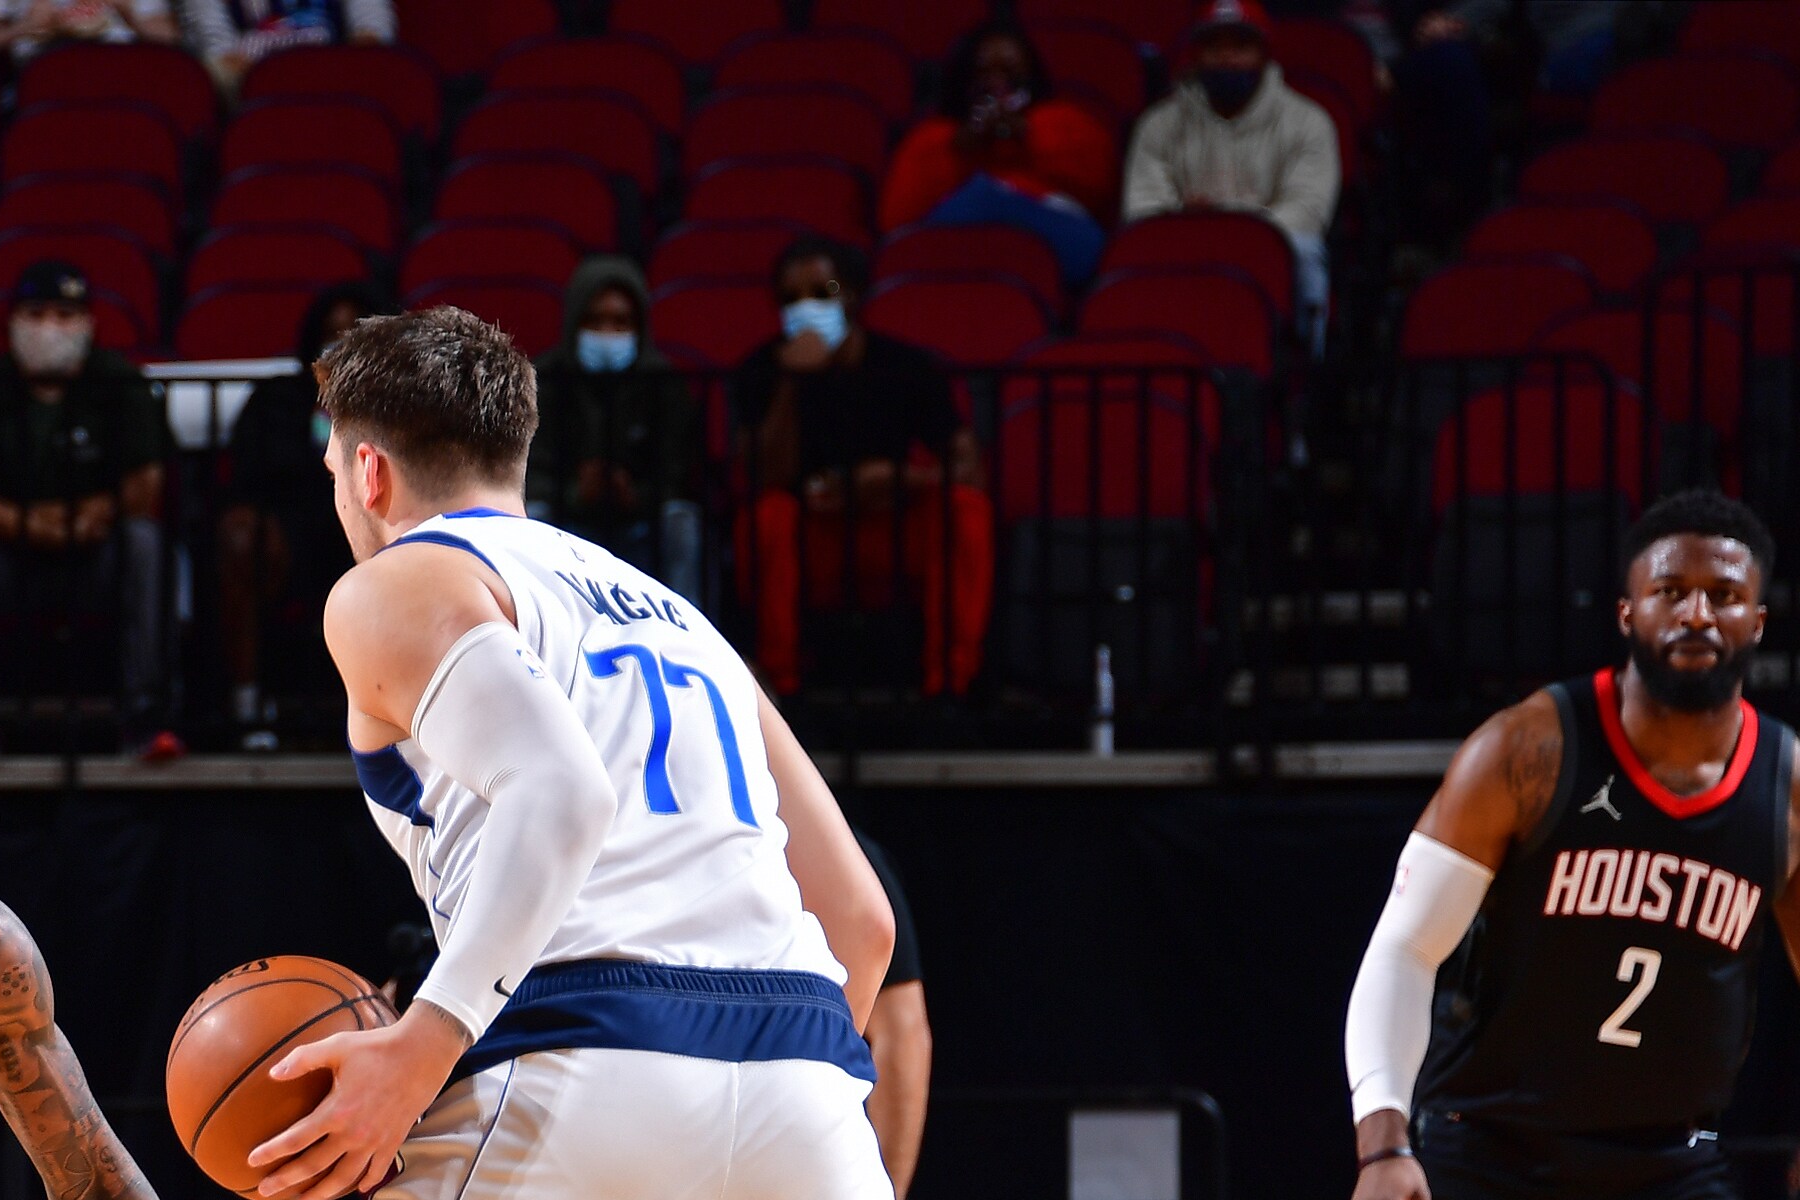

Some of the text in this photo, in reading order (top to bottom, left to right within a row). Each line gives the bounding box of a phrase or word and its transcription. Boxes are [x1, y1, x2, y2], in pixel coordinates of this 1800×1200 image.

[582, 643, 763, 836] 77
[1543, 849, 1762, 951] HOUSTON
[1597, 946, 1663, 1048] 2
